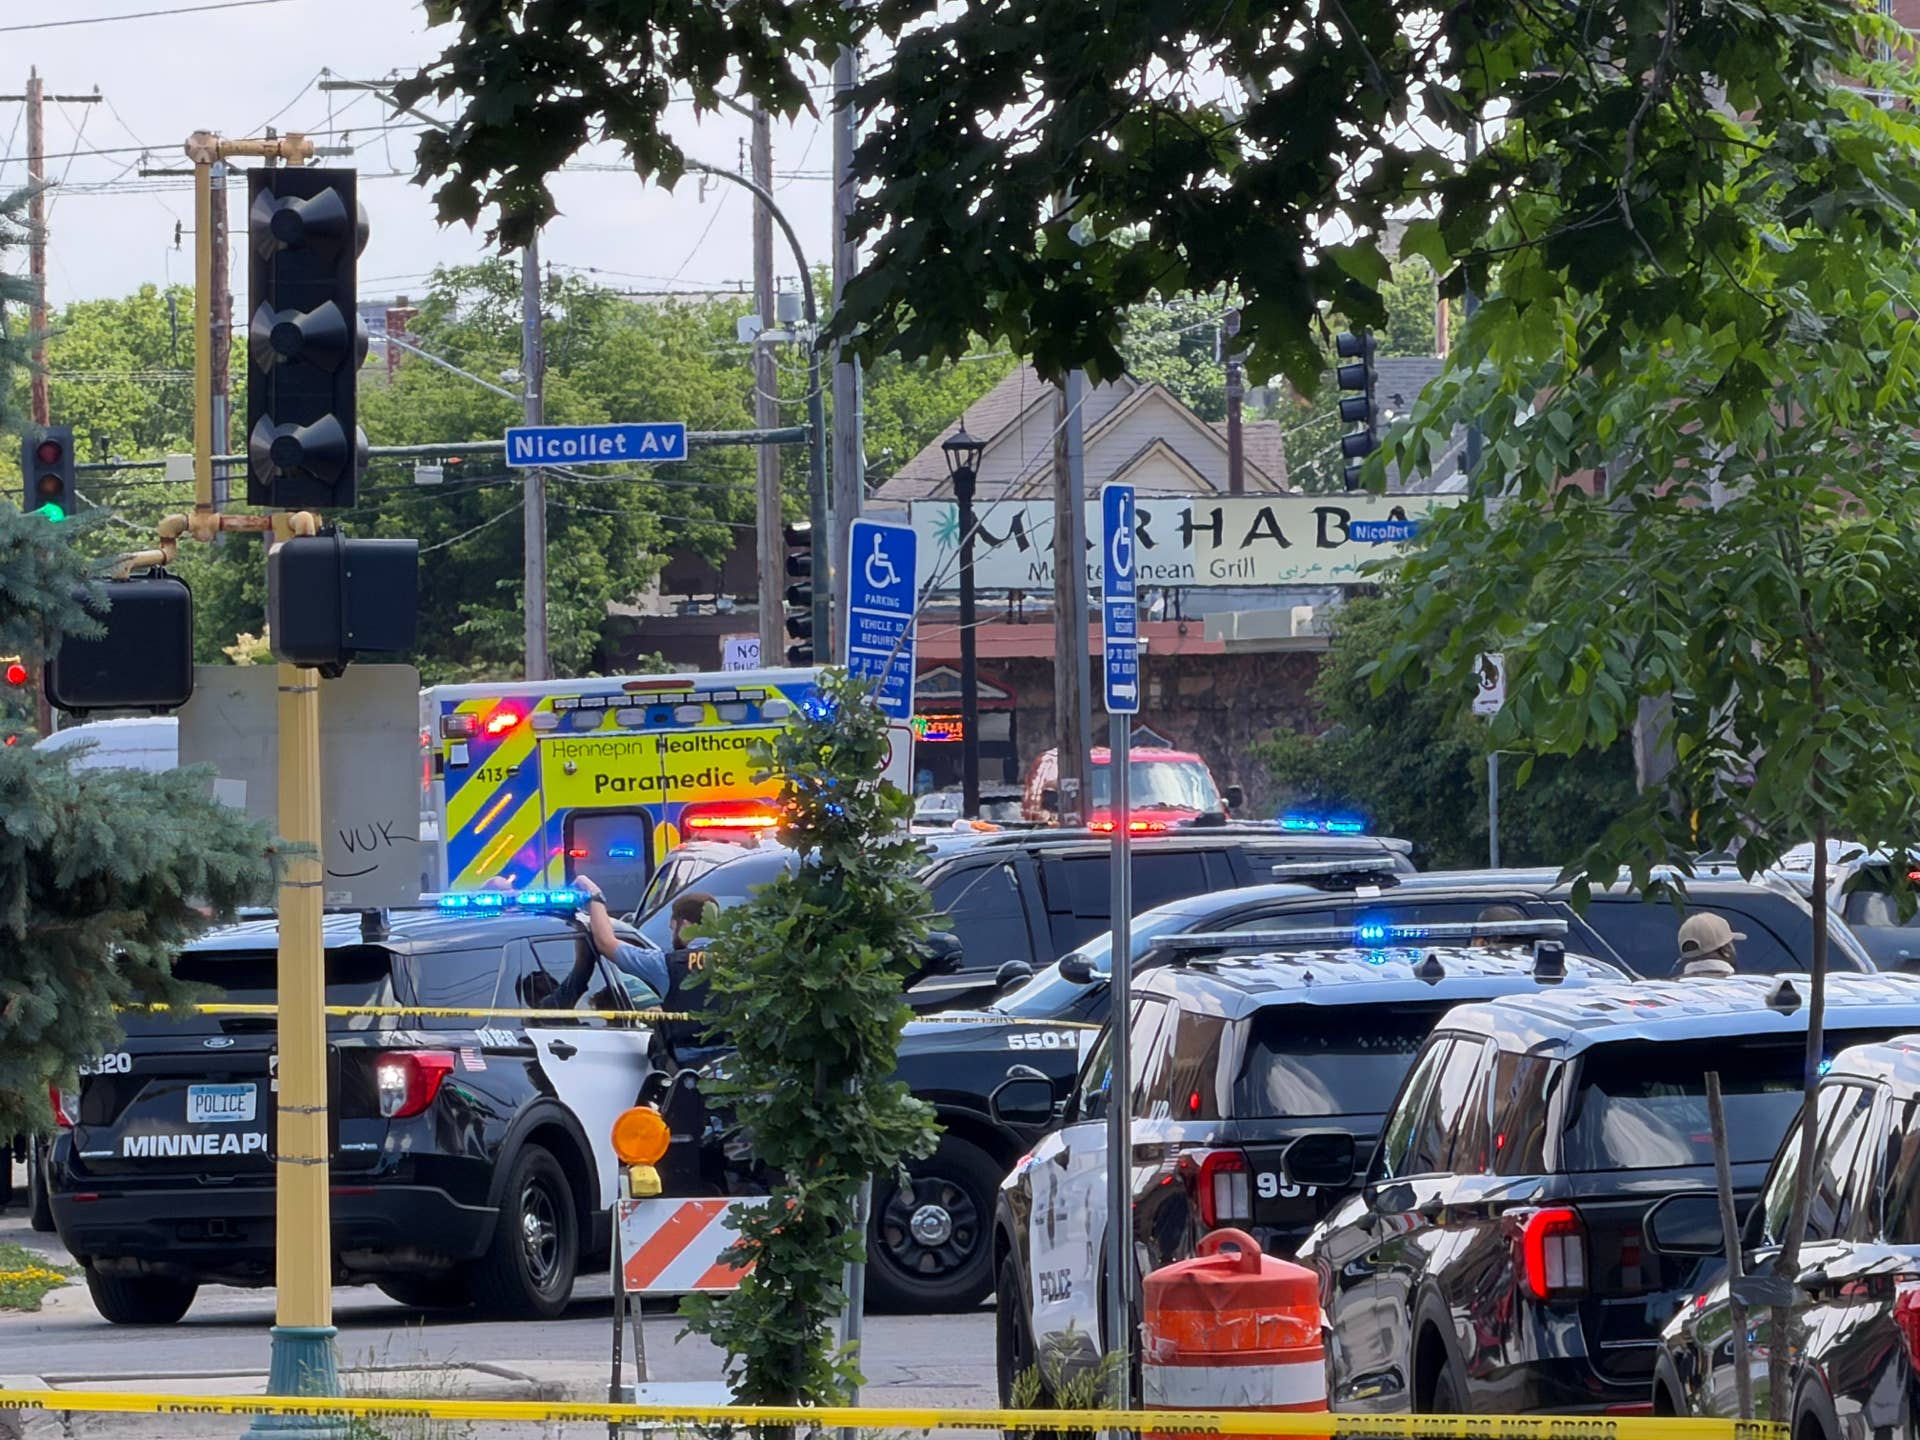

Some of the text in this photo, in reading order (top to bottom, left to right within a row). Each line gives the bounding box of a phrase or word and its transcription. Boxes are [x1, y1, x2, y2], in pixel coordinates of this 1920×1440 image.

[515, 431, 677, 458] Nicollet Av
[1210, 556, 1255, 579] Grill
[864, 593, 900, 608] PARKING
[860, 617, 893, 632] VEHICLE
[861, 632, 898, 648] REQUIRE
[737, 643, 759, 659] NO
[894, 661, 910, 674] FINE
[551, 740, 643, 760] Hennepin
[476, 767, 503, 783] 413
[594, 768, 736, 794] Paramedic
[1007, 1031, 1078, 1050] 5501
[195, 1094, 247, 1113] POLICE
